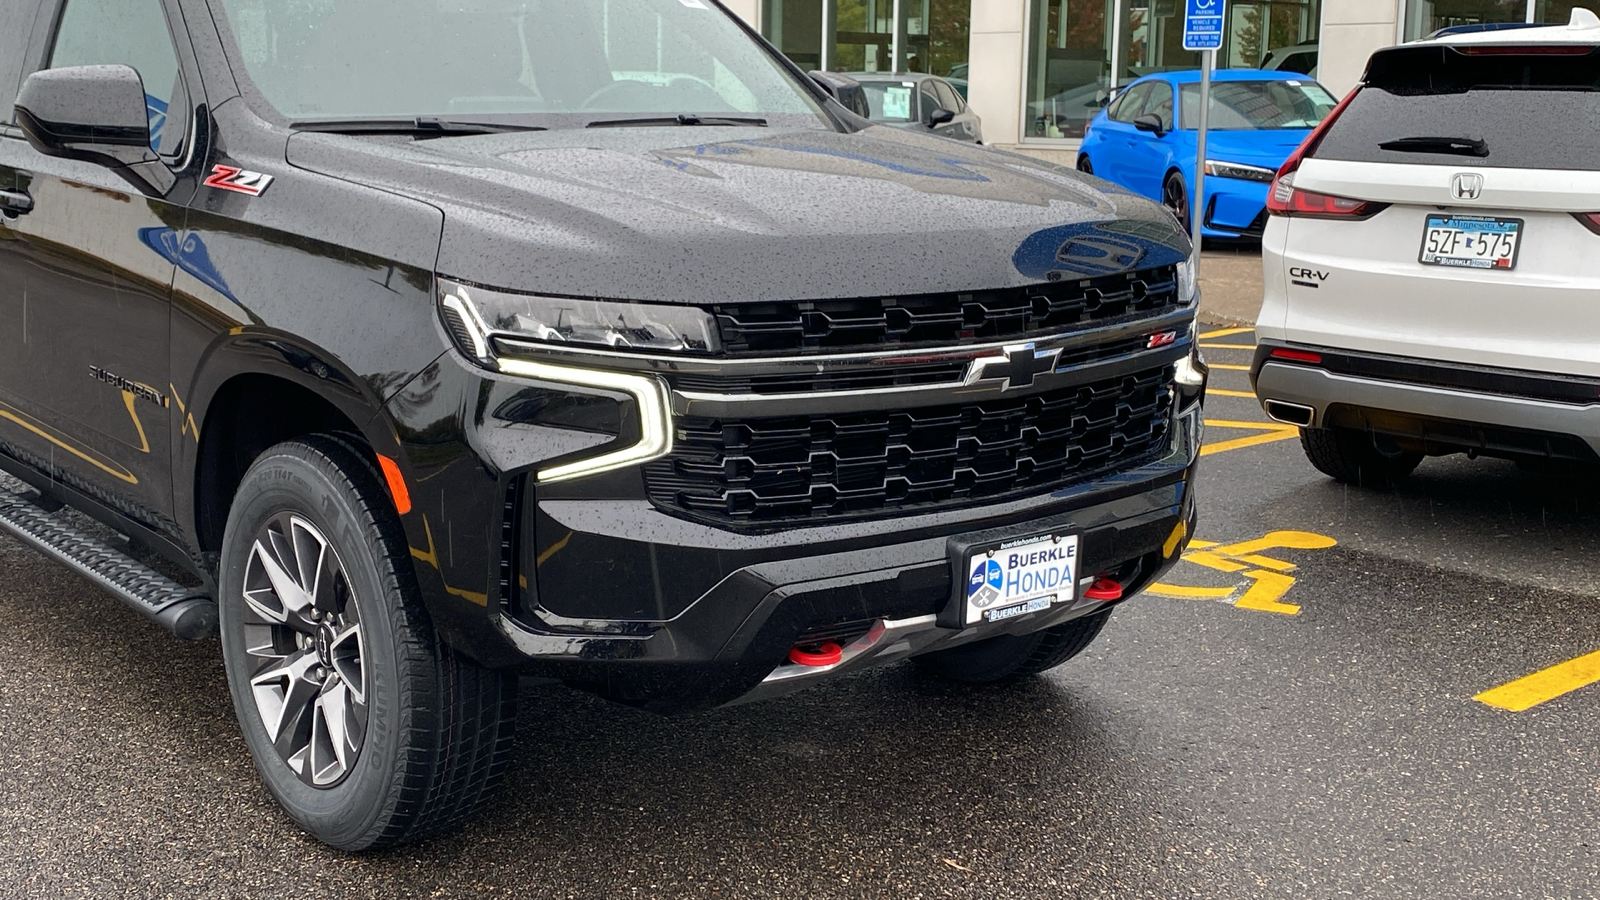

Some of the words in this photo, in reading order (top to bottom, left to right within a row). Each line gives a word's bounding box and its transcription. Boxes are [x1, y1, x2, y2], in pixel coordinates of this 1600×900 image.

[1452, 220, 1495, 230] Minnesota
[1427, 229, 1464, 255] SZF
[1476, 232, 1514, 258] 575
[1289, 267, 1330, 281] CR-V
[1000, 534, 1052, 550] buerklehonda.com
[1008, 545, 1076, 570] BUERKLE
[1006, 564, 1072, 598] HONDA
[989, 603, 1027, 621] BUERKLE
[1027, 599, 1050, 611] HONDA
